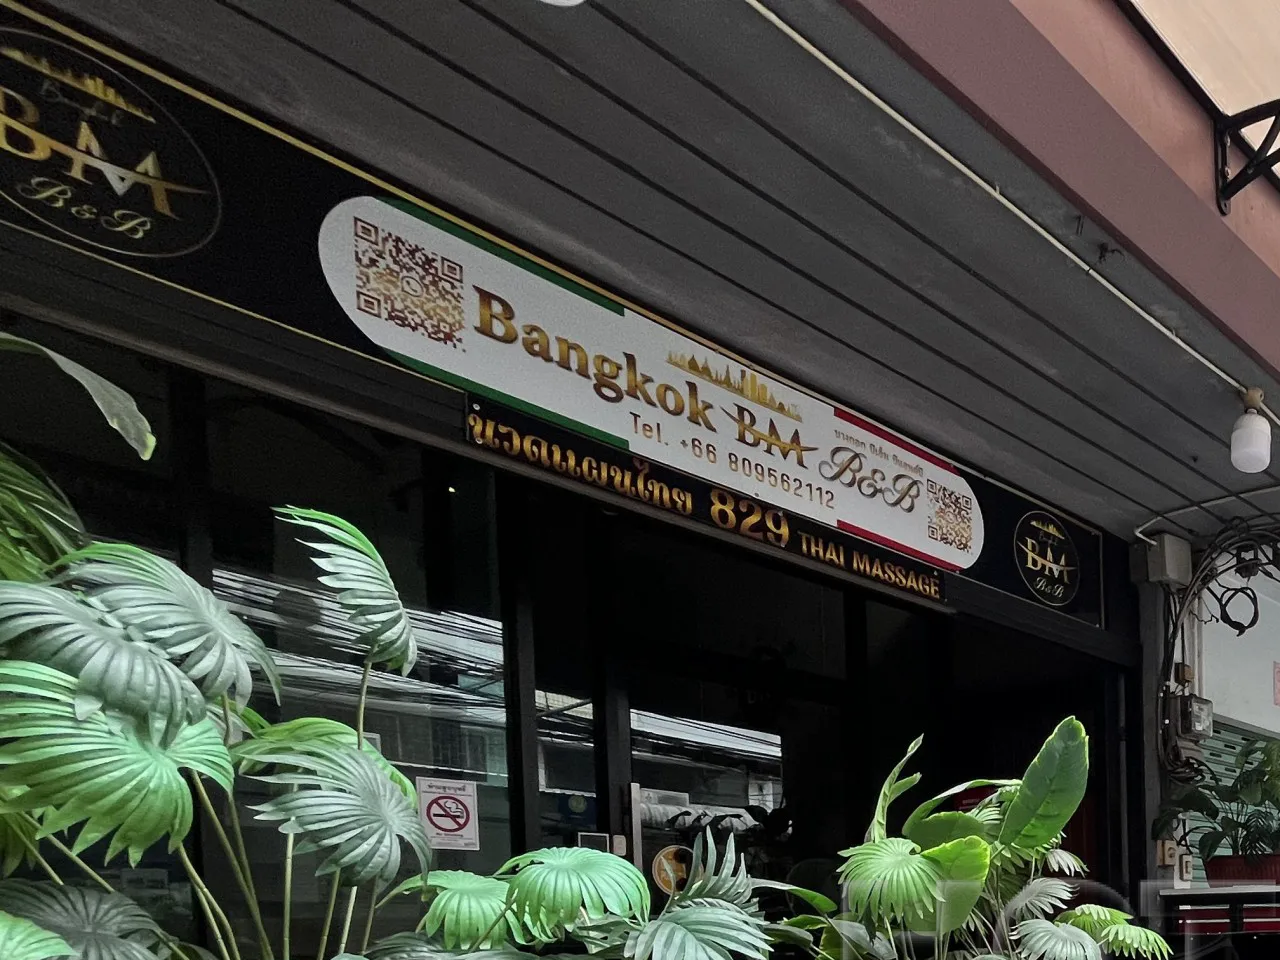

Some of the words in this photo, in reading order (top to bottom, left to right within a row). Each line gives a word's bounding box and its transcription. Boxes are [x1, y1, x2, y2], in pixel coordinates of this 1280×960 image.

[472, 284, 717, 433] Bangkok
[724, 402, 816, 469] BM
[630, 411, 669, 445] Tel.
[680, 437, 717, 464] +66
[728, 452, 835, 510] 809562112
[468, 413, 693, 515] นวดแผนไทย
[710, 488, 790, 548] 829
[798, 531, 845, 569] THAI
[853, 551, 940, 600] MASSAGE
